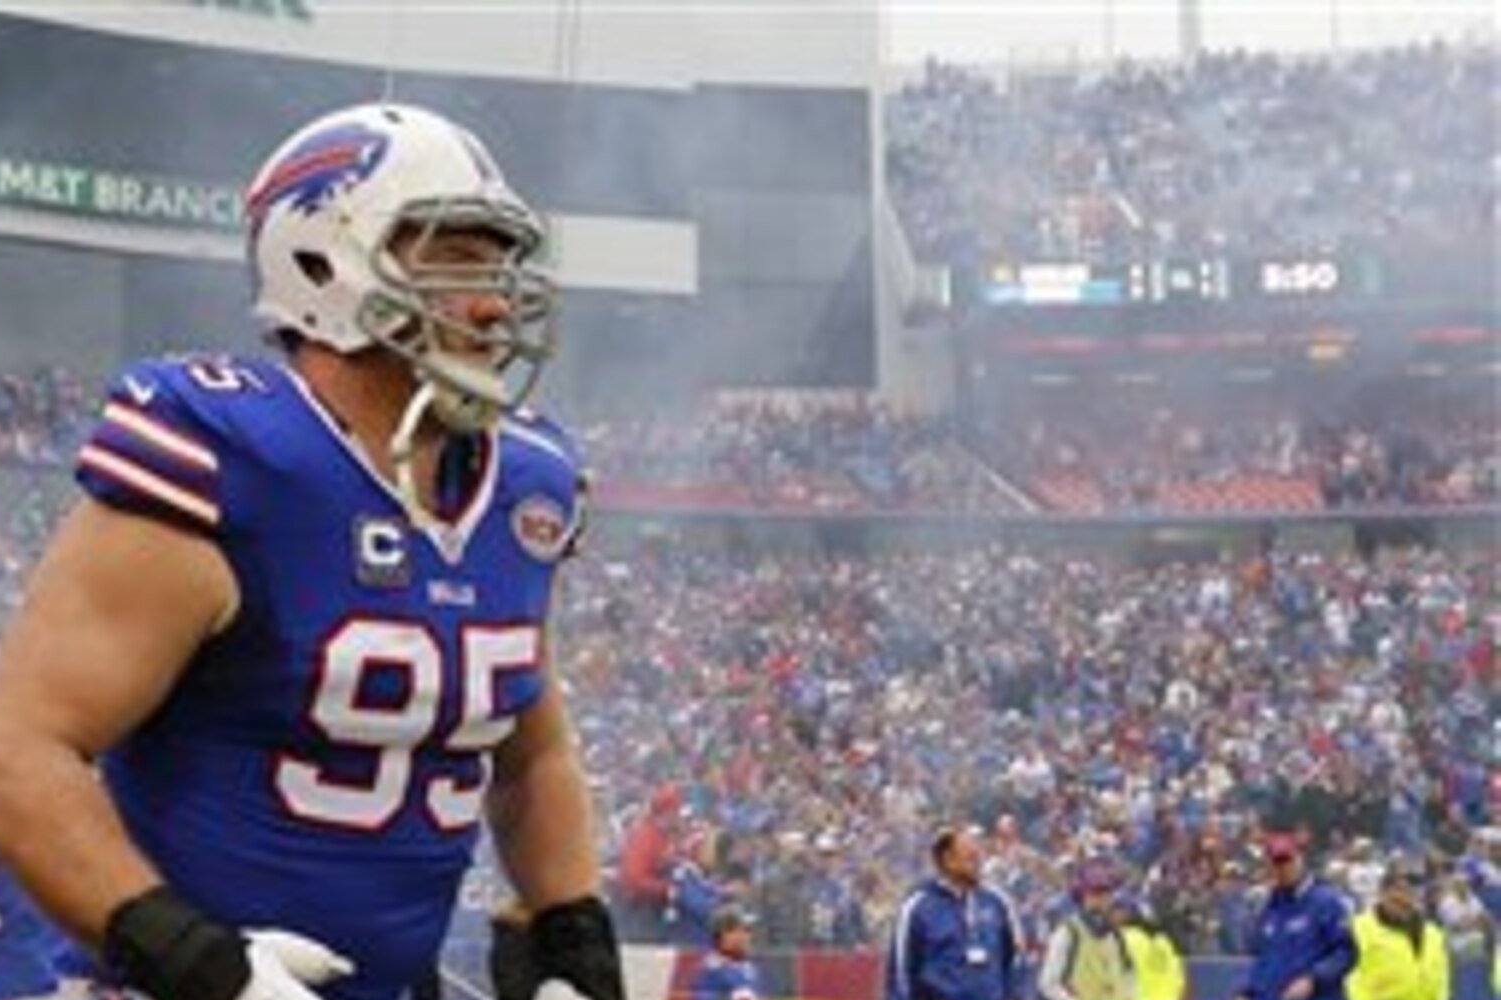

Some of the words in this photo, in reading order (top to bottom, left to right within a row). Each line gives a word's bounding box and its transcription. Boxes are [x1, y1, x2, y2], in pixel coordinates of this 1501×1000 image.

[0, 160, 87, 205] M&T
[362, 522, 402, 565] C
[272, 614, 541, 830] 95
